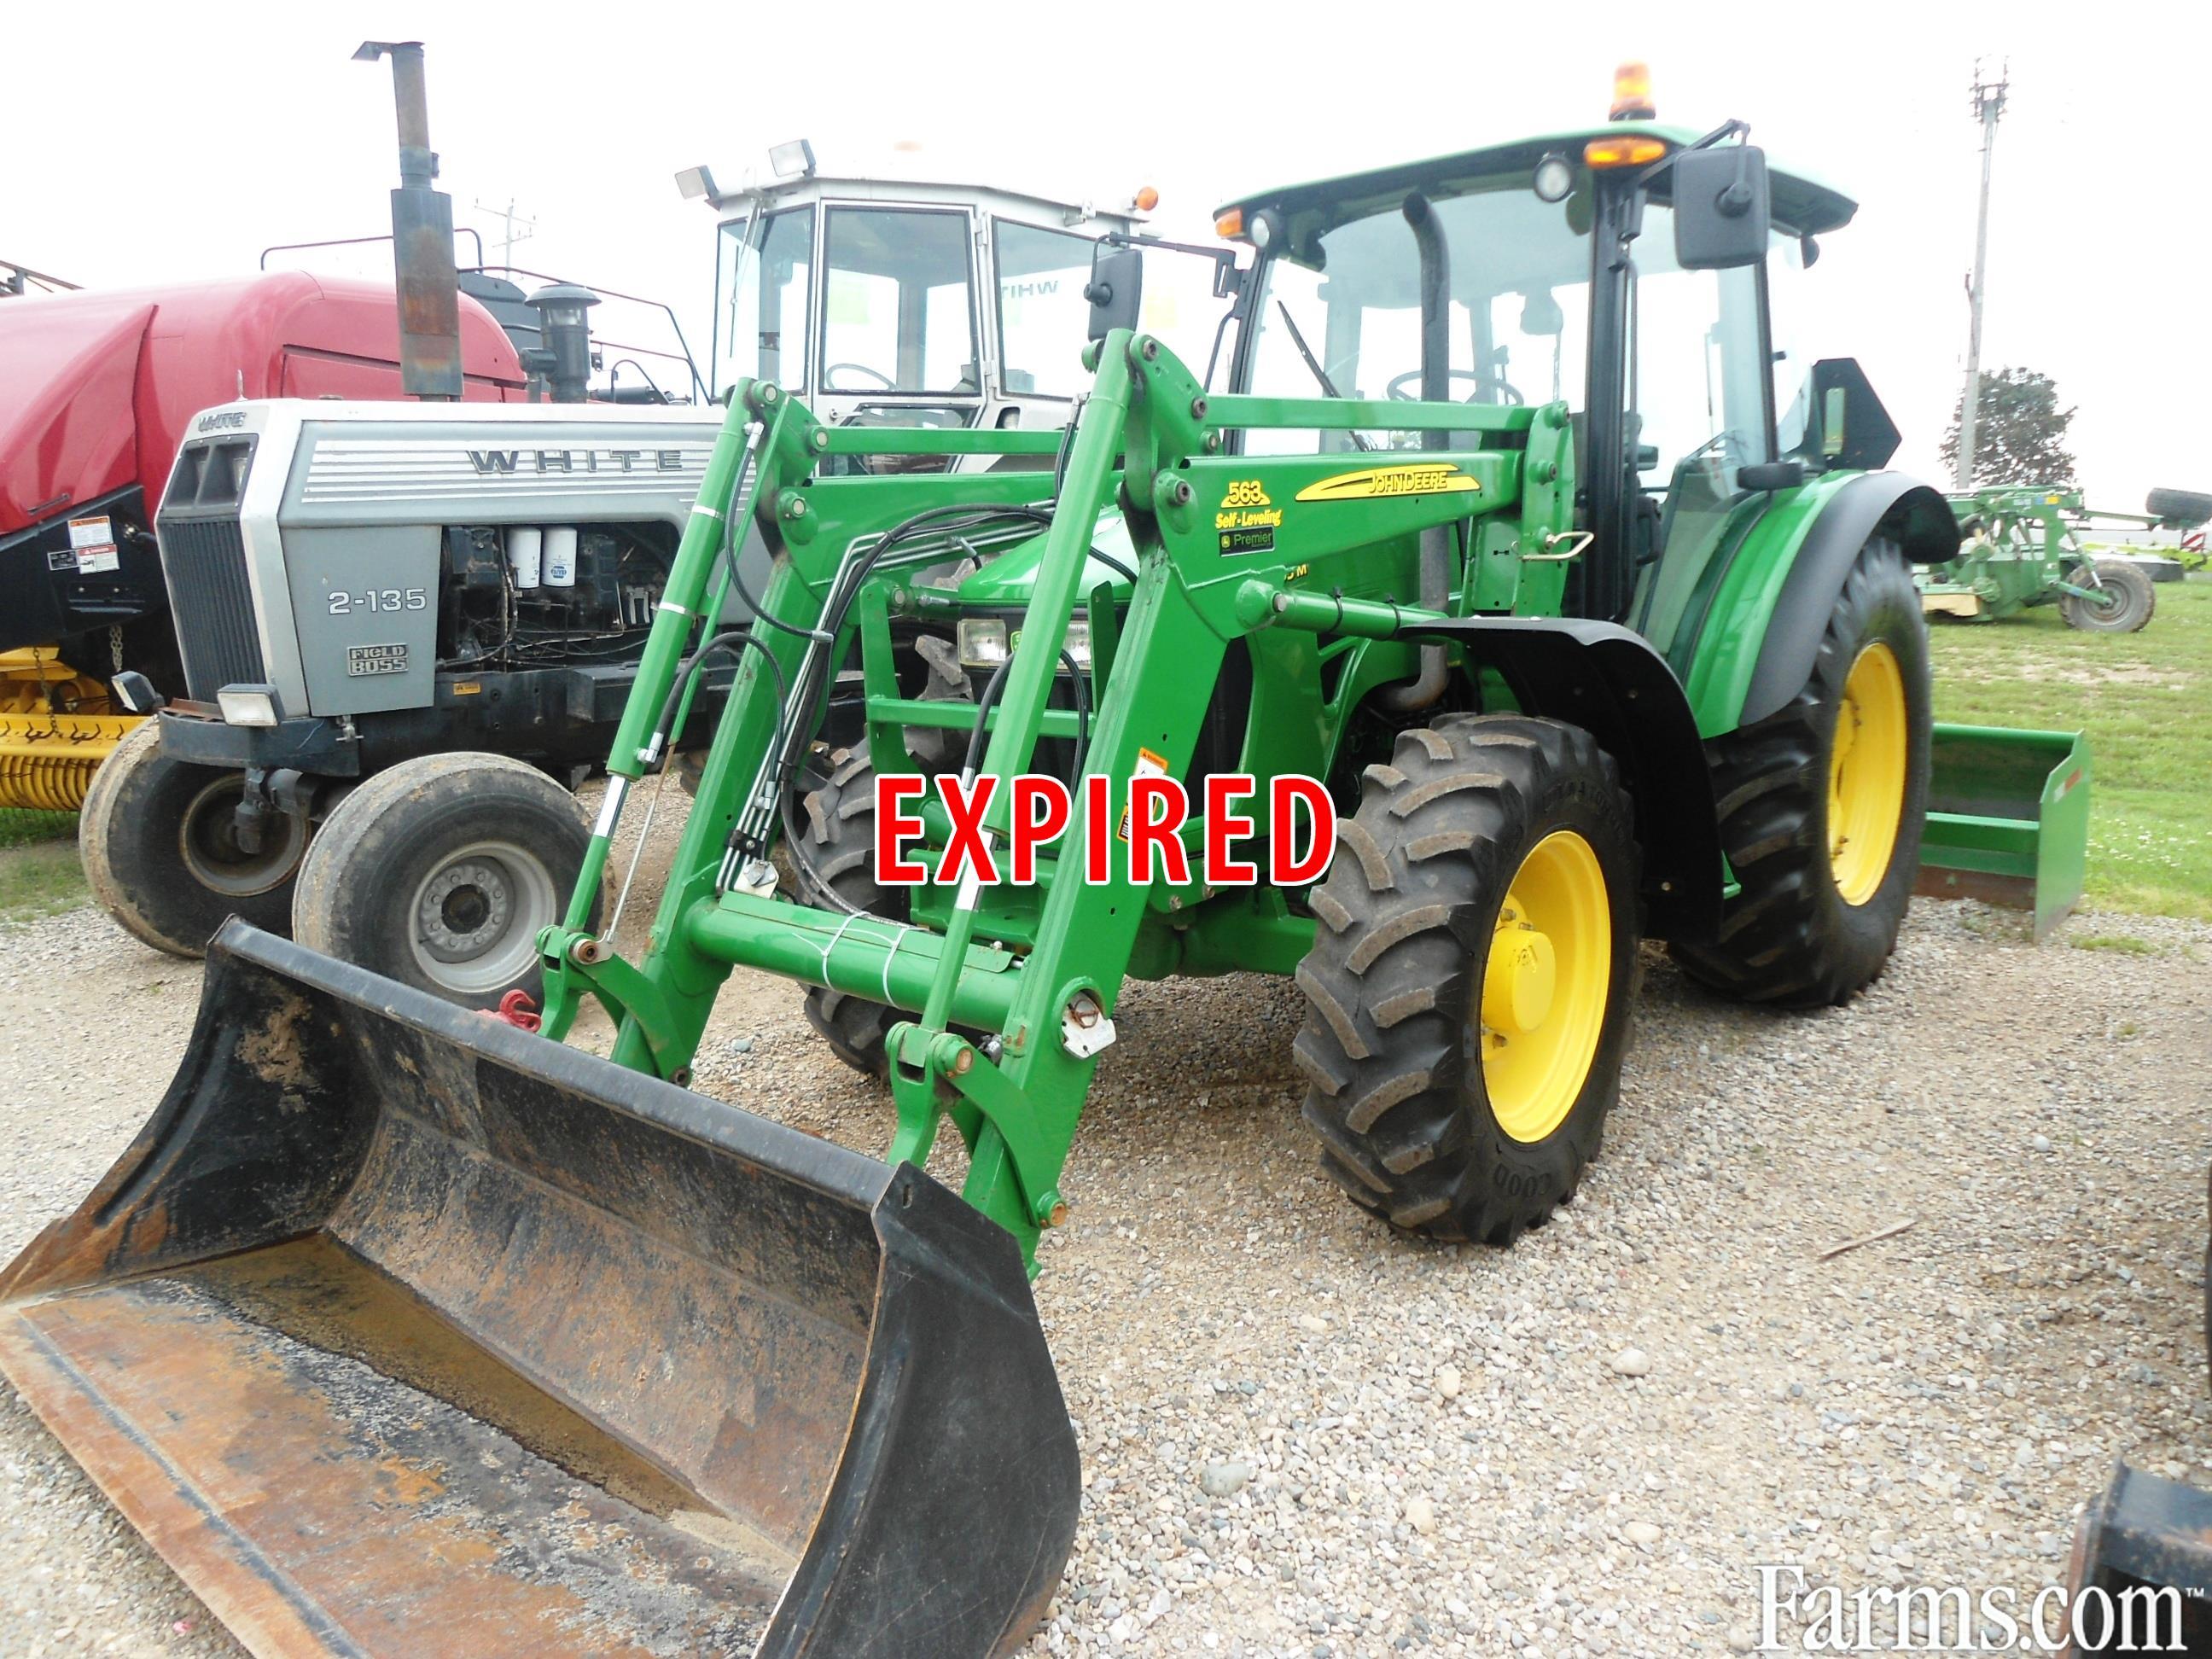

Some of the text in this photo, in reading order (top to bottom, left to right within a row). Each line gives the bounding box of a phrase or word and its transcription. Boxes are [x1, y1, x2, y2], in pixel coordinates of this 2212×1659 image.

[466, 449, 683, 474] WHITE
[1228, 480, 1262, 505] 563
[1233, 531, 1272, 546] Premier
[328, 587, 428, 615] 2-135
[351, 659, 407, 673] BOSS
